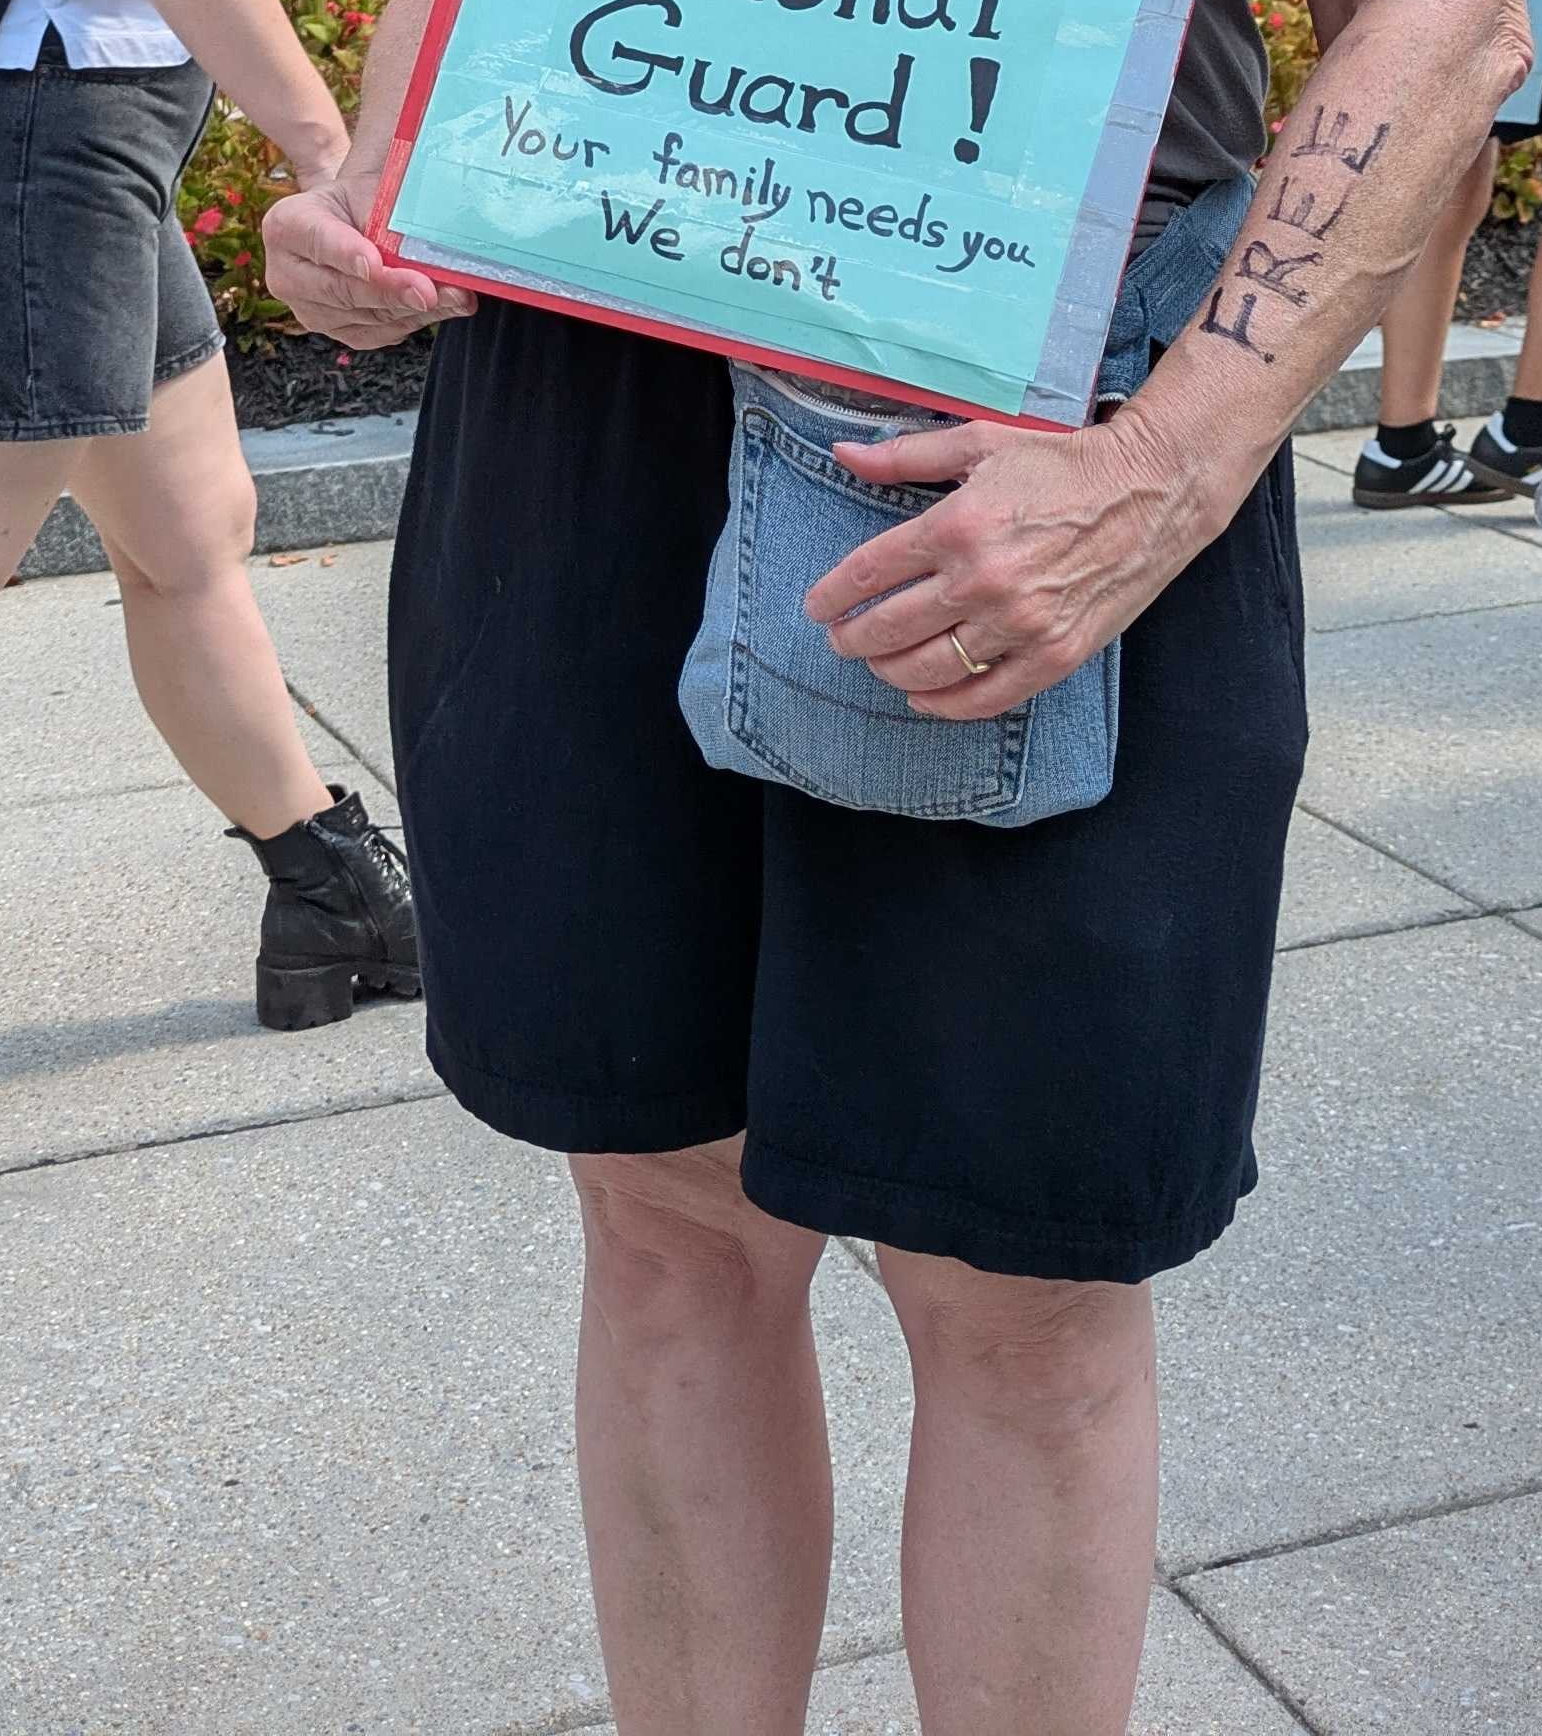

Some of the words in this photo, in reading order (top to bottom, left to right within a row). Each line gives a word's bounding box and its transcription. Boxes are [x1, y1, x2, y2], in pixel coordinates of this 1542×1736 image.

[501, 95, 610, 168] Your
[653, 132, 791, 224] family
[807, 194, 949, 248] needs
[935, 231, 1036, 273] you
[601, 190, 685, 261] We
[721, 224, 841, 301] don't
[1200, 104, 1390, 363] FREE
